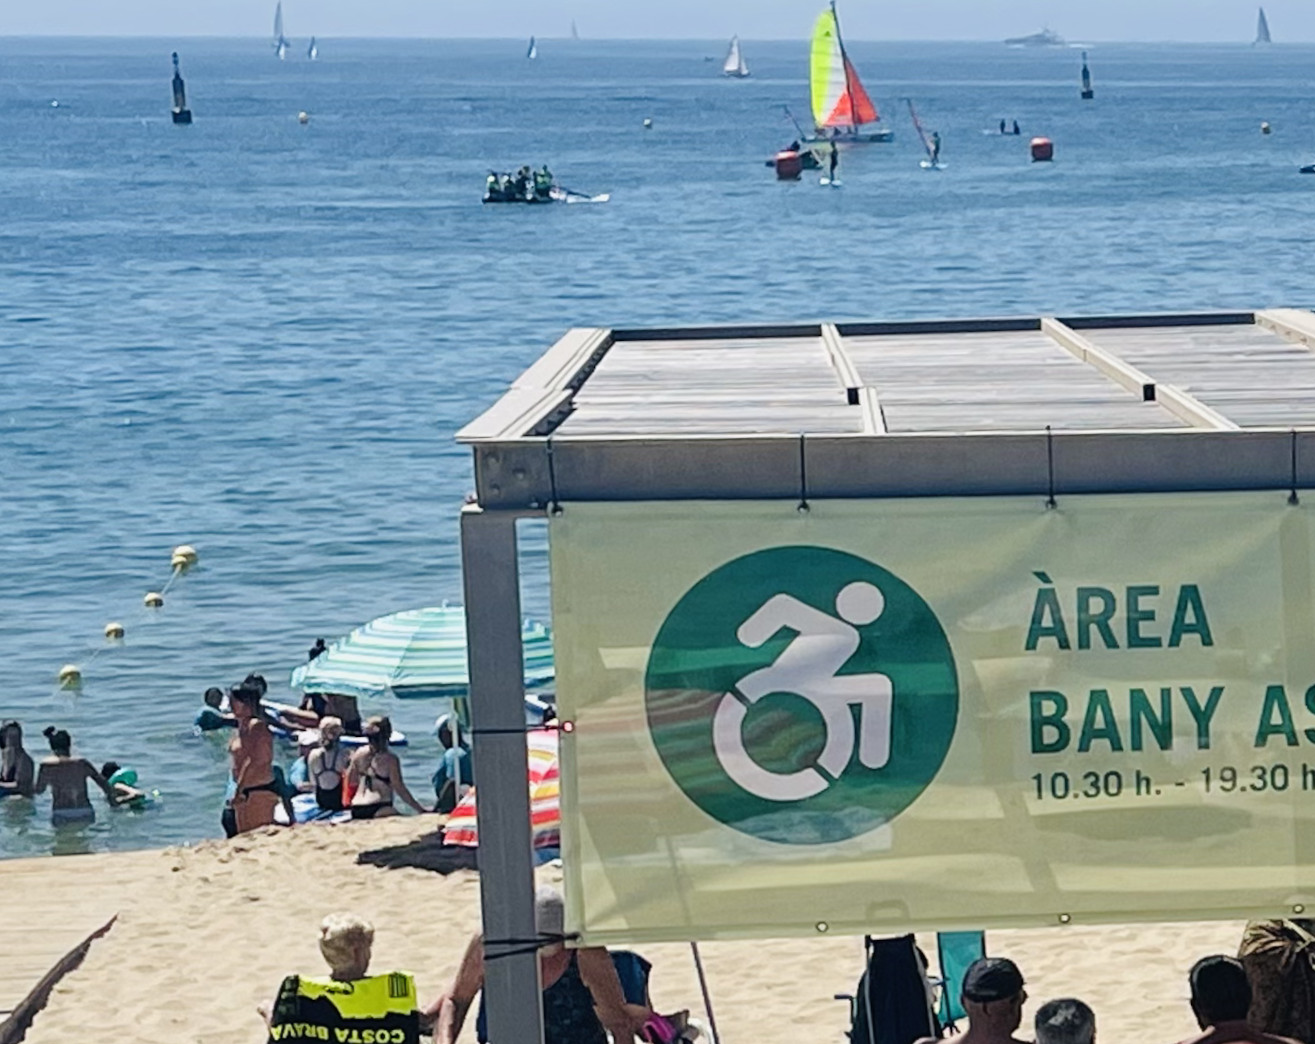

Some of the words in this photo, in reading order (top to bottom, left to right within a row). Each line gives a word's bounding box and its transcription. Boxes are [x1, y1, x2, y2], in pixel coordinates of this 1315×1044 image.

[1024, 570, 1215, 651] ÀREA
[1028, 686, 1226, 755] BANY
[1030, 770, 1124, 800] 10.30
[1135, 769, 1163, 796] h.
[1201, 763, 1290, 793] 19.30
[271, 1022, 330, 1042] BRAVA
[334, 1026, 406, 1044] COSTA
